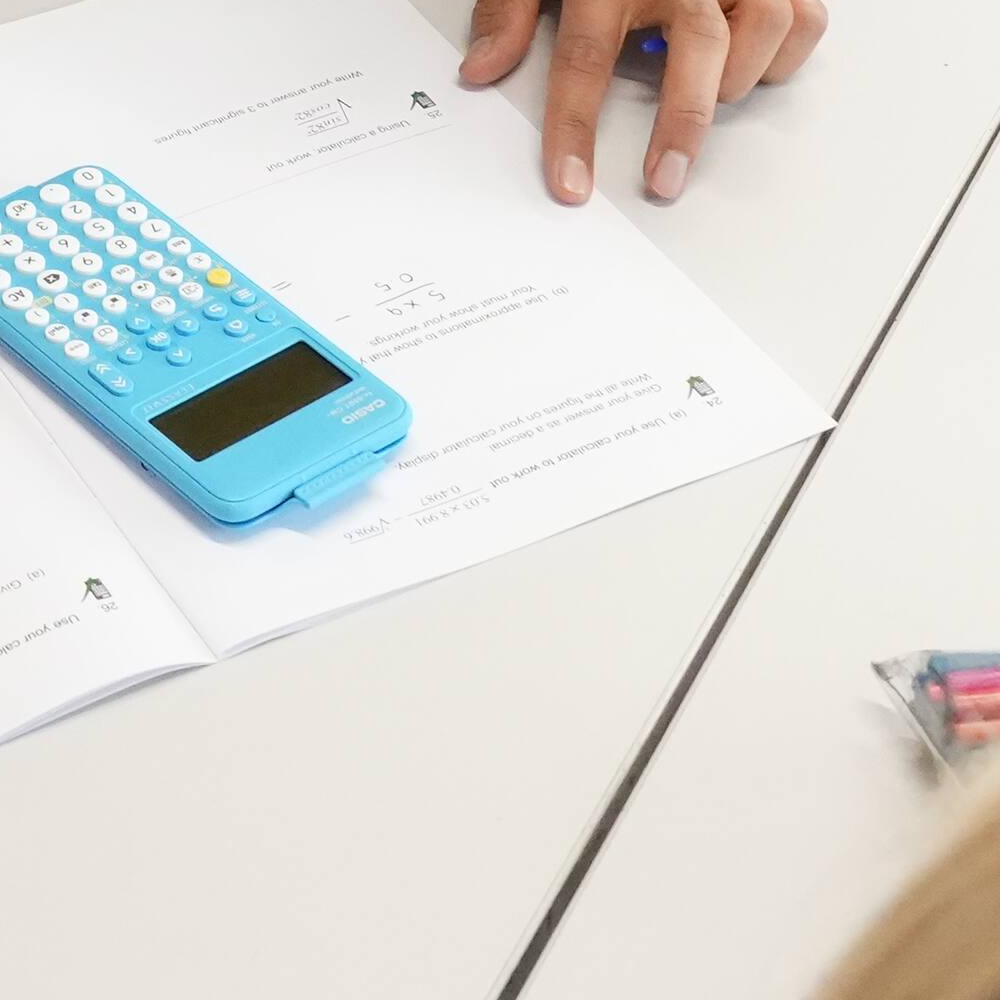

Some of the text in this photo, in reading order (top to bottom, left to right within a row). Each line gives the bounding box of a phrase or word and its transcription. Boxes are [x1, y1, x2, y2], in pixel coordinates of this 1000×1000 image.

[334, 70, 364, 82] Write
[310, 78, 334, 92] your
[270, 88, 308, 104] answer
[192, 110, 246, 132] significant
[376, 120, 412, 134] Using
[286, 152, 312, 166] work
[266, 162, 284, 172] out
[8, 290, 26, 302] AC
[510, 284, 536, 296] Your
[552, 286, 570, 296] (b)
[480, 294, 508, 308] must
[524, 294, 548, 306] Use
[448, 304, 478, 318] show
[422, 314, 448, 328] your
[438, 302, 522, 336] approximations
[424, 332, 438, 340] to
[394, 338, 424, 352] show
[368, 350, 392, 362] that
[620, 372, 652, 386] Write
[584, 388, 604, 400] the
[604, 384, 618, 394] all
[634, 384, 662, 396] Give
[542, 396, 584, 414] figures
[608, 392, 632, 406] your
[342, 398, 386, 424] CASIO
[524, 410, 542, 422] on
[564, 402, 604, 422] answer
[668, 410, 688, 420] (a)
[500, 416, 524, 432] your
[546, 420, 560, 428] as
[640, 418, 666, 430] Use
[614, 426, 640, 440] your
[442, 428, 496, 454] calculator
[556, 436, 612, 462] calculator
[542, 458, 556, 466] to
[510, 464, 540, 478] work
[490, 476, 510, 488] out
[26, 568, 46, 582] (a)
[52, 614, 80, 628] Use
[24, 624, 52, 642] your
